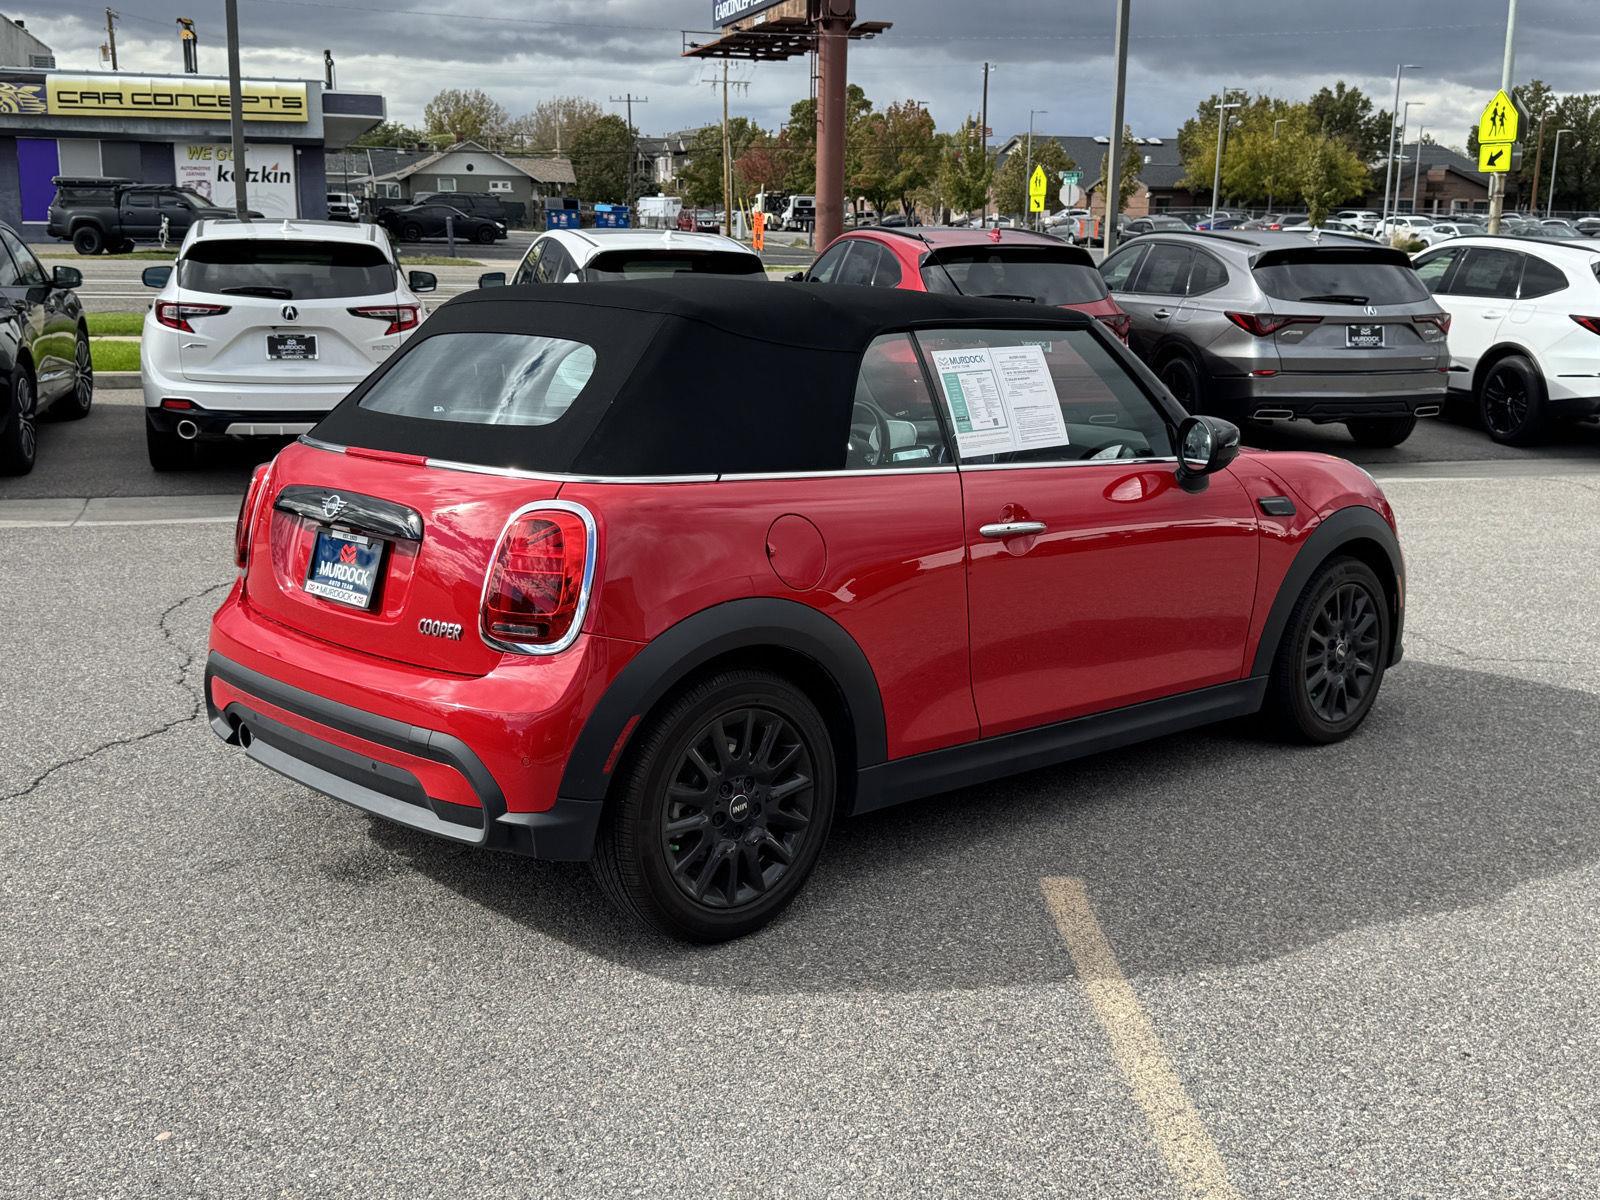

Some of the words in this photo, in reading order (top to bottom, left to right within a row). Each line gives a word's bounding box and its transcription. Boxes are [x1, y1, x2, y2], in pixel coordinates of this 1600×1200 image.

[57, 90, 123, 105] CAR
[131, 92, 303, 109] CONCEPTS
[186, 145, 213, 161] WE
[217, 163, 291, 184] ktzkin
[949, 354, 986, 365] MURDOCK
[319, 560, 370, 586] MURDOCK
[418, 617, 462, 641] COOPER
[732, 801, 748, 814] MINI
